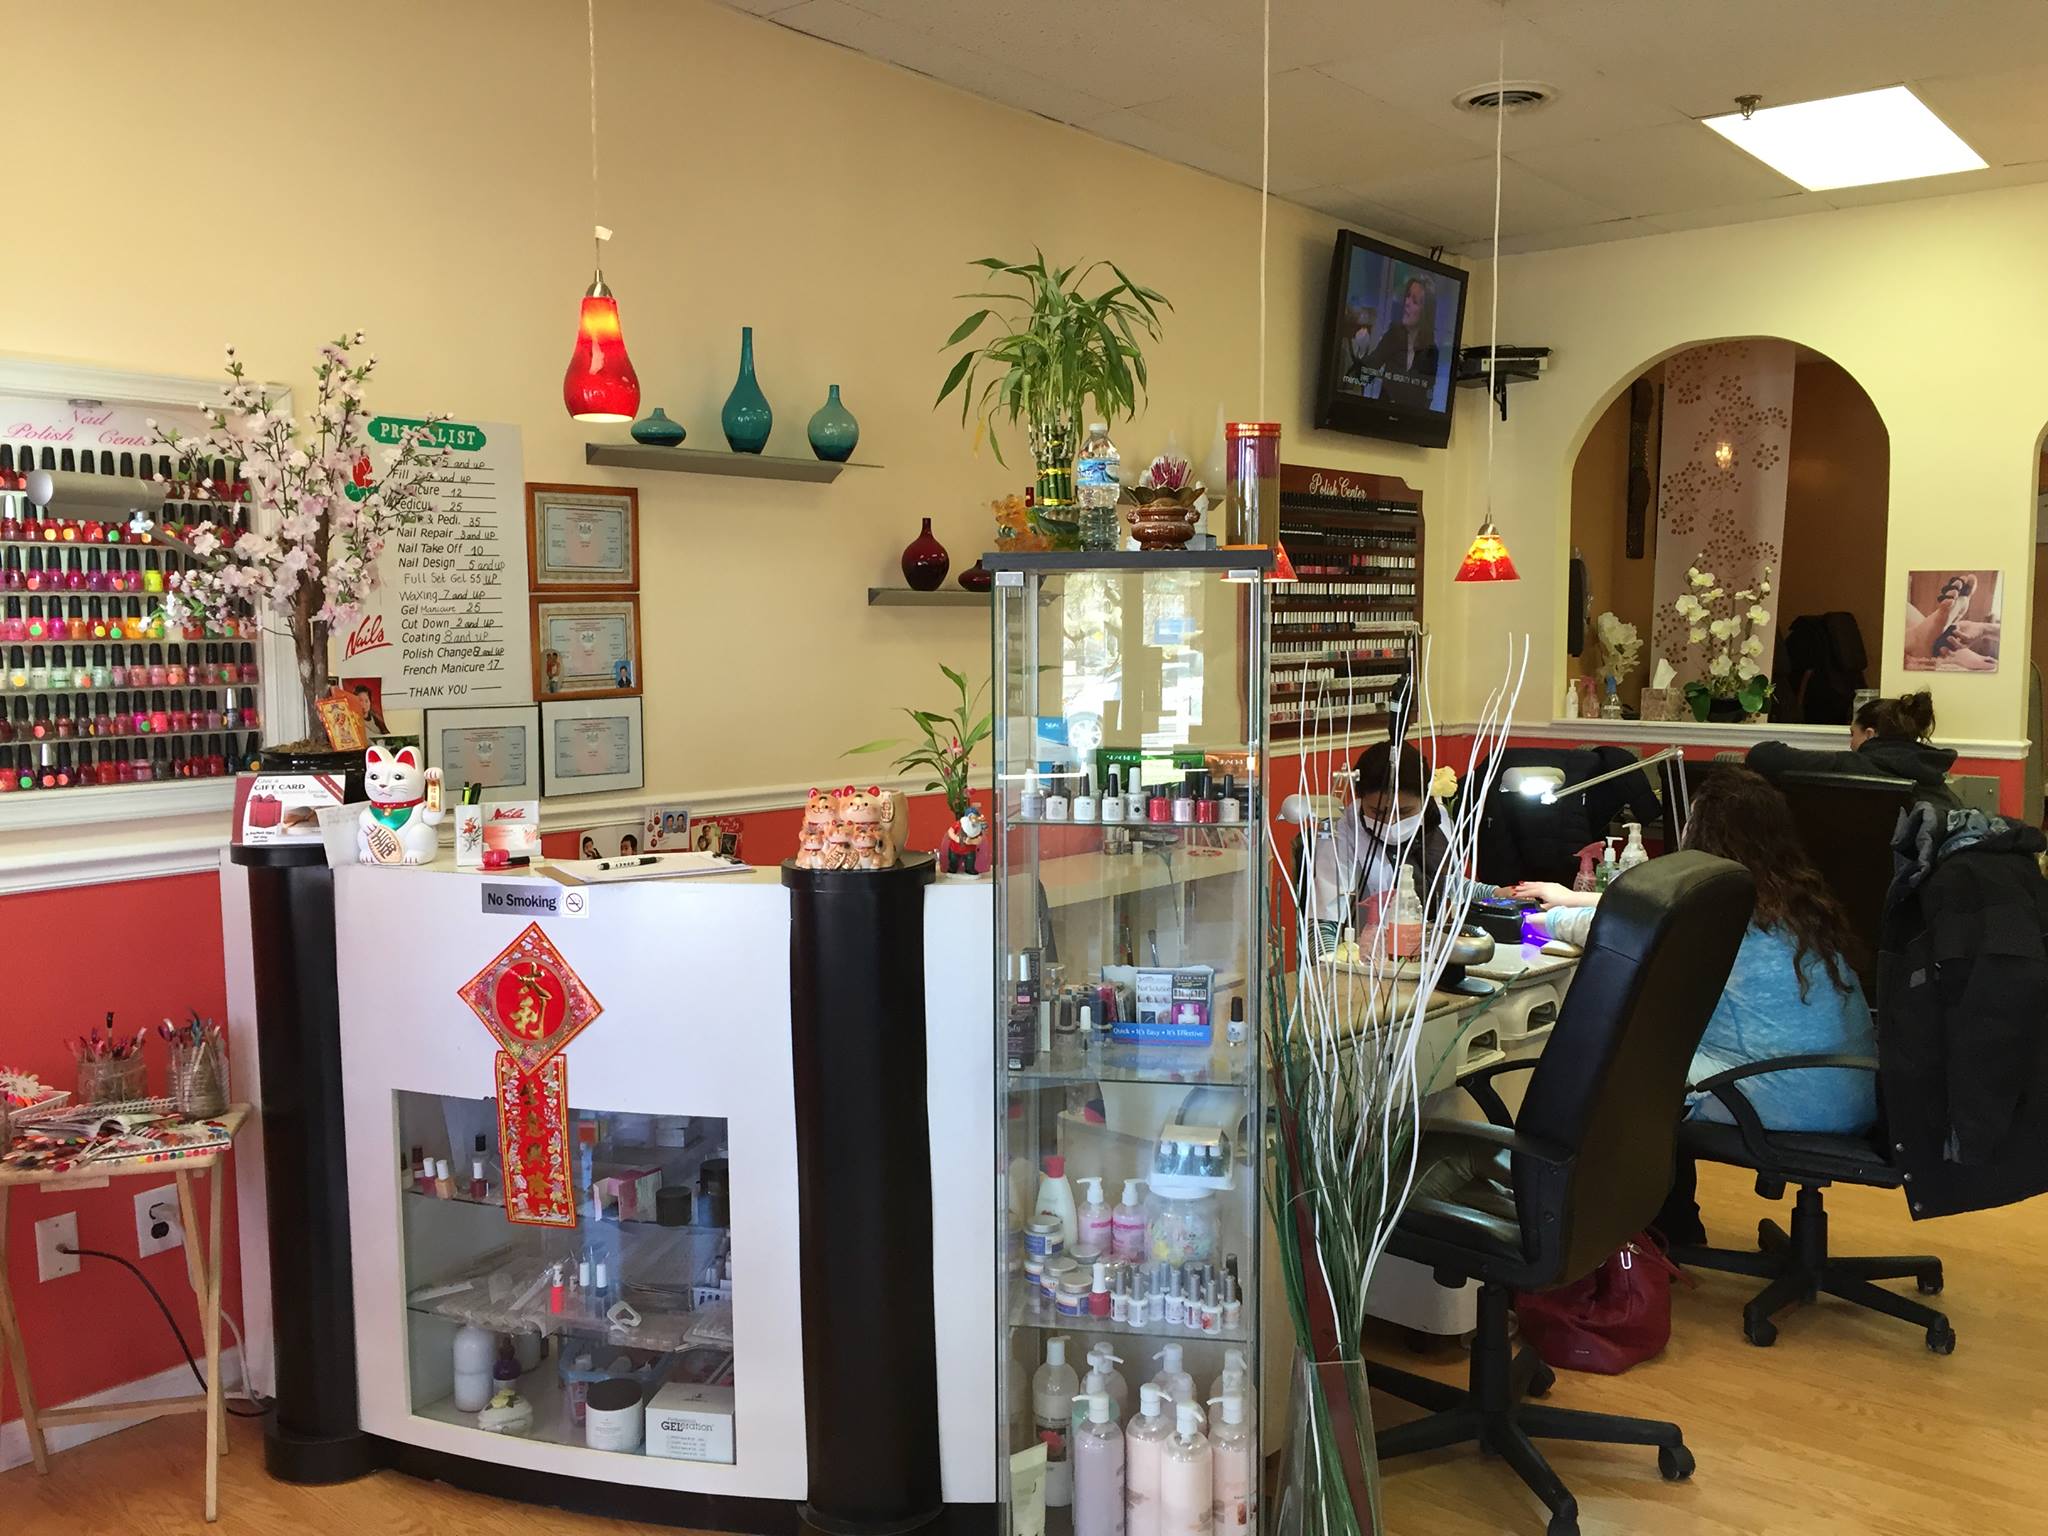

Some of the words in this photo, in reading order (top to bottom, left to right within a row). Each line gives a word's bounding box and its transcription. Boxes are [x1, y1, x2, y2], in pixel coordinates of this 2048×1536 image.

[71, 409, 113, 426] Nail
[2, 423, 76, 442] Polish
[438, 428, 475, 445] LIST
[450, 488, 463, 497] 12
[1309, 472, 1339, 496] Polish
[1339, 476, 1368, 500] Center
[450, 502, 463, 512] 25
[437, 514, 461, 526] Pedi.
[469, 517, 481, 527] 35
[396, 527, 416, 538] Nail
[420, 528, 454, 540] Repair
[397, 543, 418, 553] Nail
[421, 543, 444, 554] Take
[446, 543, 463, 554] Off
[470, 546, 484, 556] 10
[398, 558, 419, 568] Nail
[422, 557, 456, 571] Design
[469, 560, 476, 570] 5
[477, 559, 493, 571] and
[404, 573, 426, 585] Full
[431, 573, 446, 584] Set
[450, 573, 466, 583] Gel
[470, 574, 481, 584] 55
[443, 589, 450, 600] 7
[452, 589, 468, 600] and
[401, 605, 418, 615] Gel
[466, 602, 481, 613] 25
[401, 619, 418, 630] Cut
[422, 618, 450, 629] Down
[456, 617, 463, 628] 2
[464, 618, 480, 629] and
[343, 614, 386, 661] Nails
[401, 632, 441, 645] Coating
[444, 629, 452, 643] 8
[453, 631, 472, 643] and
[402, 648, 432, 659] Polish
[437, 647, 474, 660] Change
[403, 664, 437, 676] French
[441, 661, 485, 674] Manicure
[487, 659, 500, 671] 17
[409, 686, 444, 698] THANK
[446, 684, 467, 696] YOU
[279, 783, 306, 791] CARD
[488, 893, 503, 906] No
[506, 893, 557, 911] Smoking
[1113, 1027, 1130, 1035] Quick
[1146, 1029, 1160, 1037] Easy
[1166, 1028, 1176, 1036] It's
[1177, 1029, 1204, 1038] Effective
